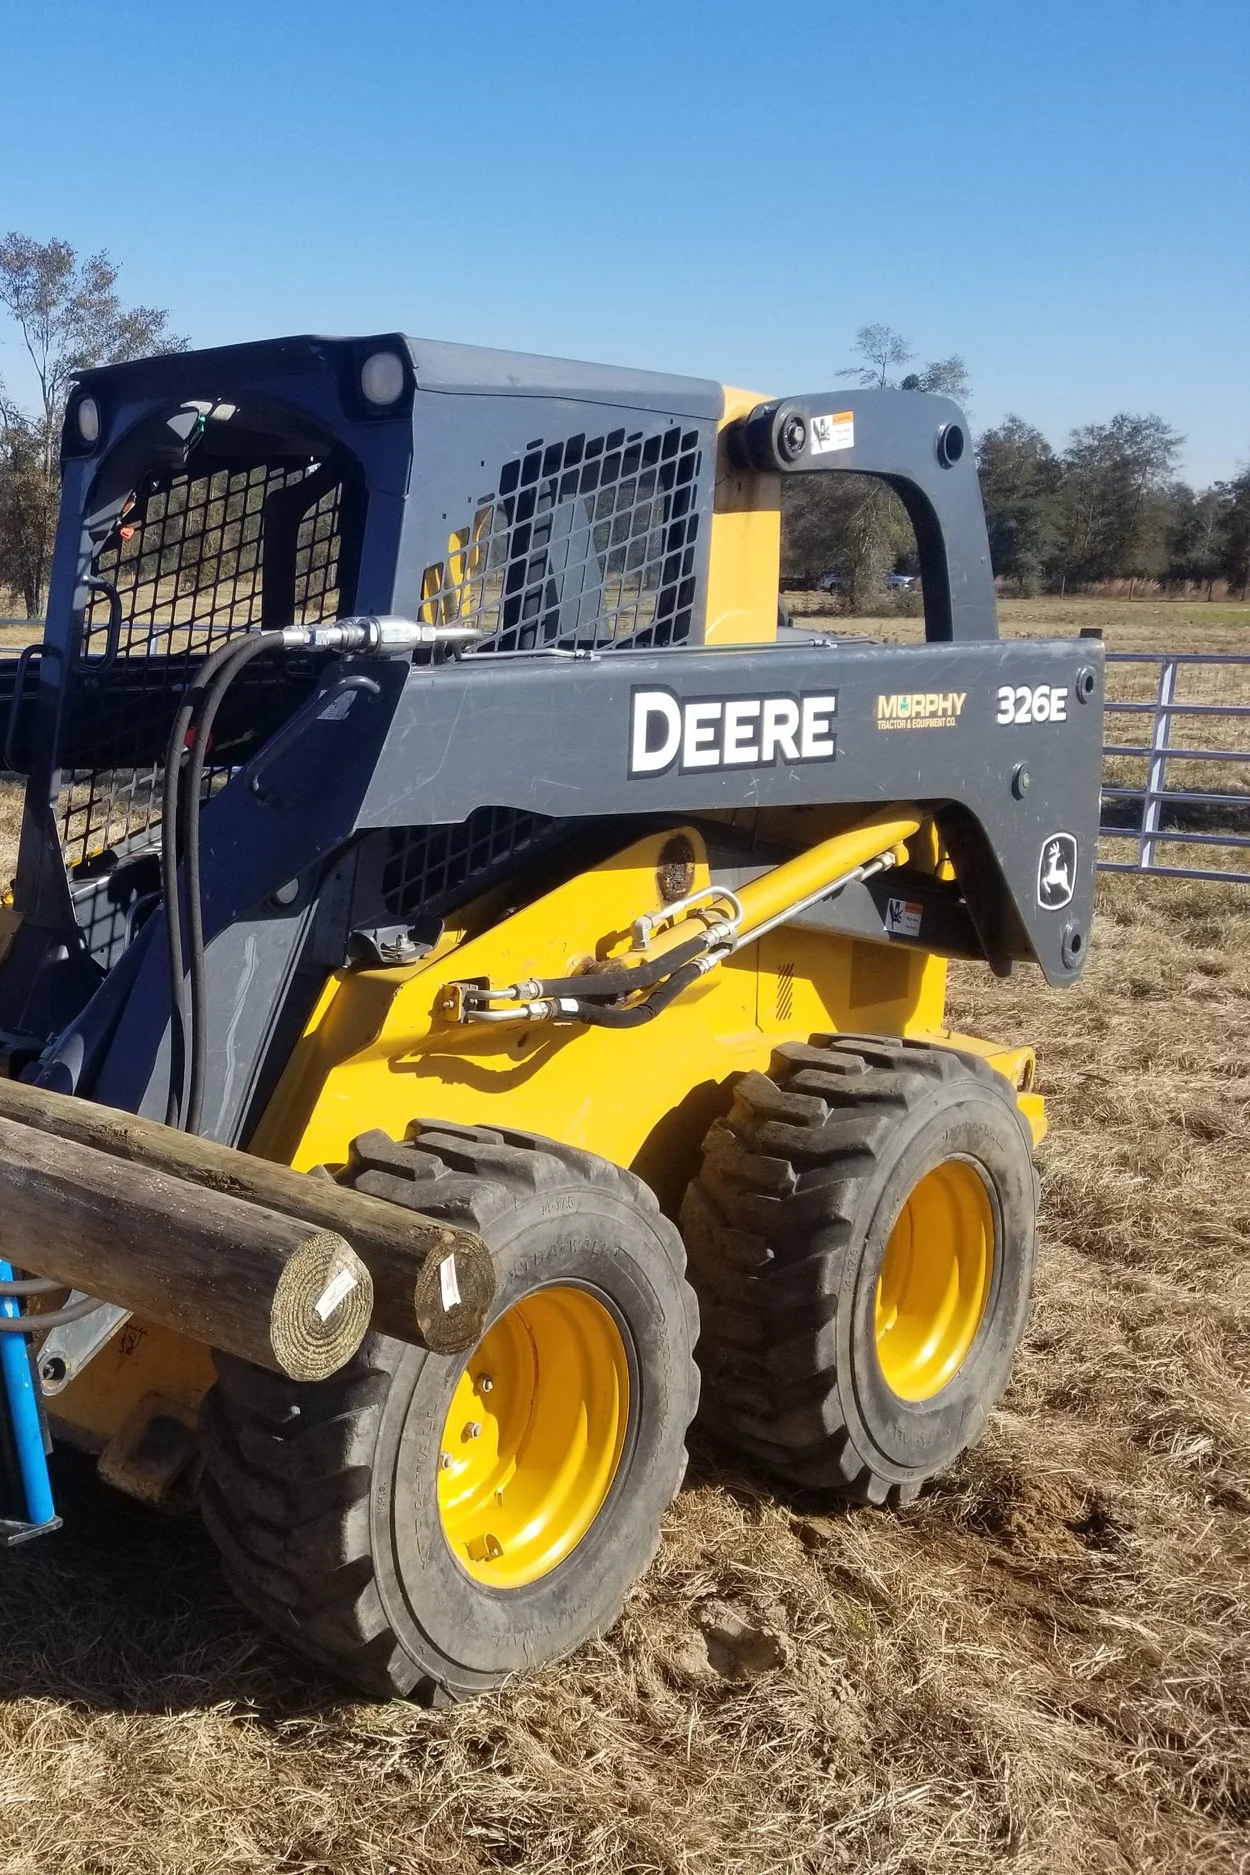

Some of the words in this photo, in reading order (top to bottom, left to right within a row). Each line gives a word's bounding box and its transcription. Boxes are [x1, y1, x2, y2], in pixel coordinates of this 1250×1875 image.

[878, 693, 967, 718] MURPHY
[997, 685, 1068, 725] 326E
[631, 691, 836, 773] DEERE
[878, 720, 906, 730] TRACTOR
[912, 718, 946, 728] EQUIPMENT
